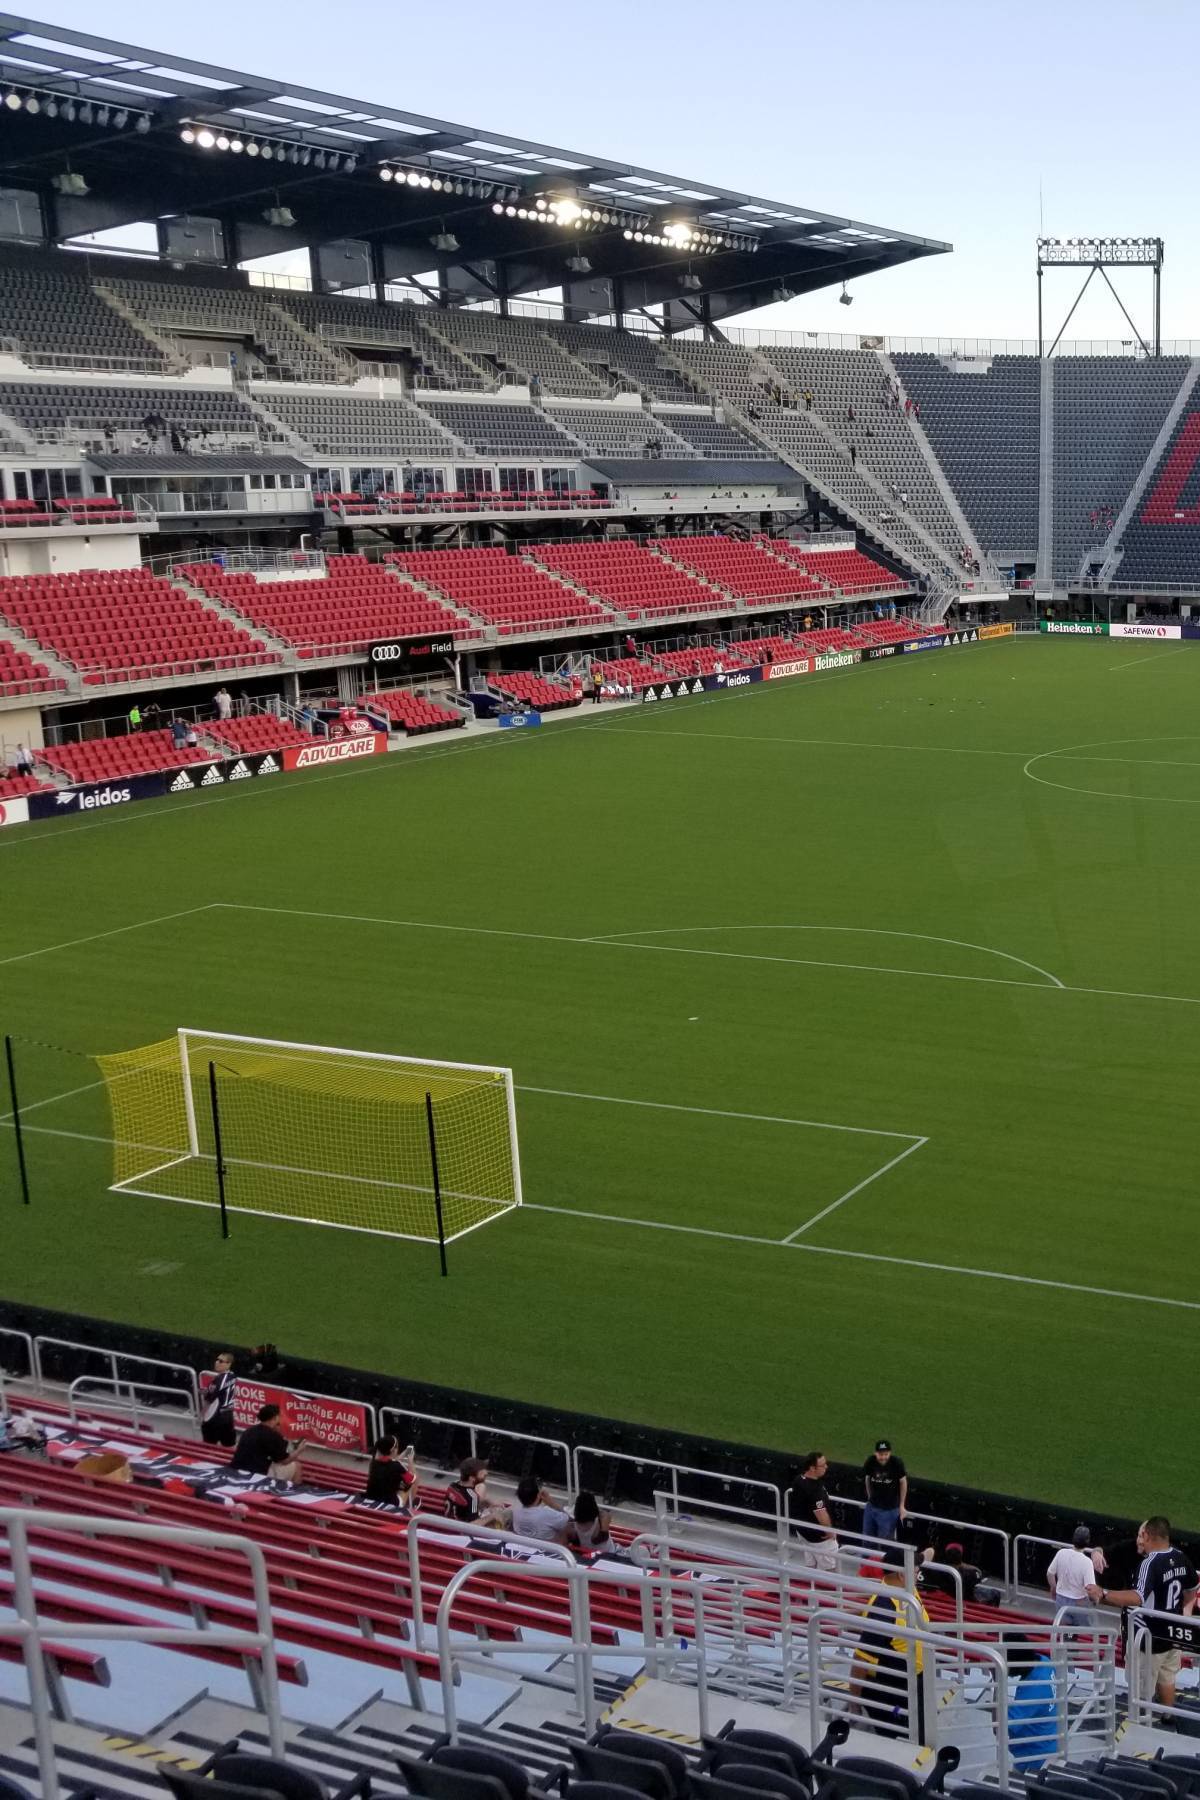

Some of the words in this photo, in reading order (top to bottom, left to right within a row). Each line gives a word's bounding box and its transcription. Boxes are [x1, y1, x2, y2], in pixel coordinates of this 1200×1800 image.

[1046, 622, 1093, 634] Heineken
[1123, 627, 1156, 636] SAFEWAY
[409, 644, 431, 656] Audi
[431, 642, 452, 654] Field
[770, 660, 809, 678] ADVOCARE
[815, 654, 854, 671] Heineken
[727, 673, 751, 687] leidos
[297, 737, 375, 767] ADVOCARE
[229, 771, 252, 781] adidas
[257, 765, 280, 775] adidas
[170, 782, 195, 792] adidas
[201, 776, 224, 786] adidas
[78, 786, 131, 809] leidos
[233, 1384, 266, 1402] MOKE
[1167, 1625, 1193, 1641] 135
